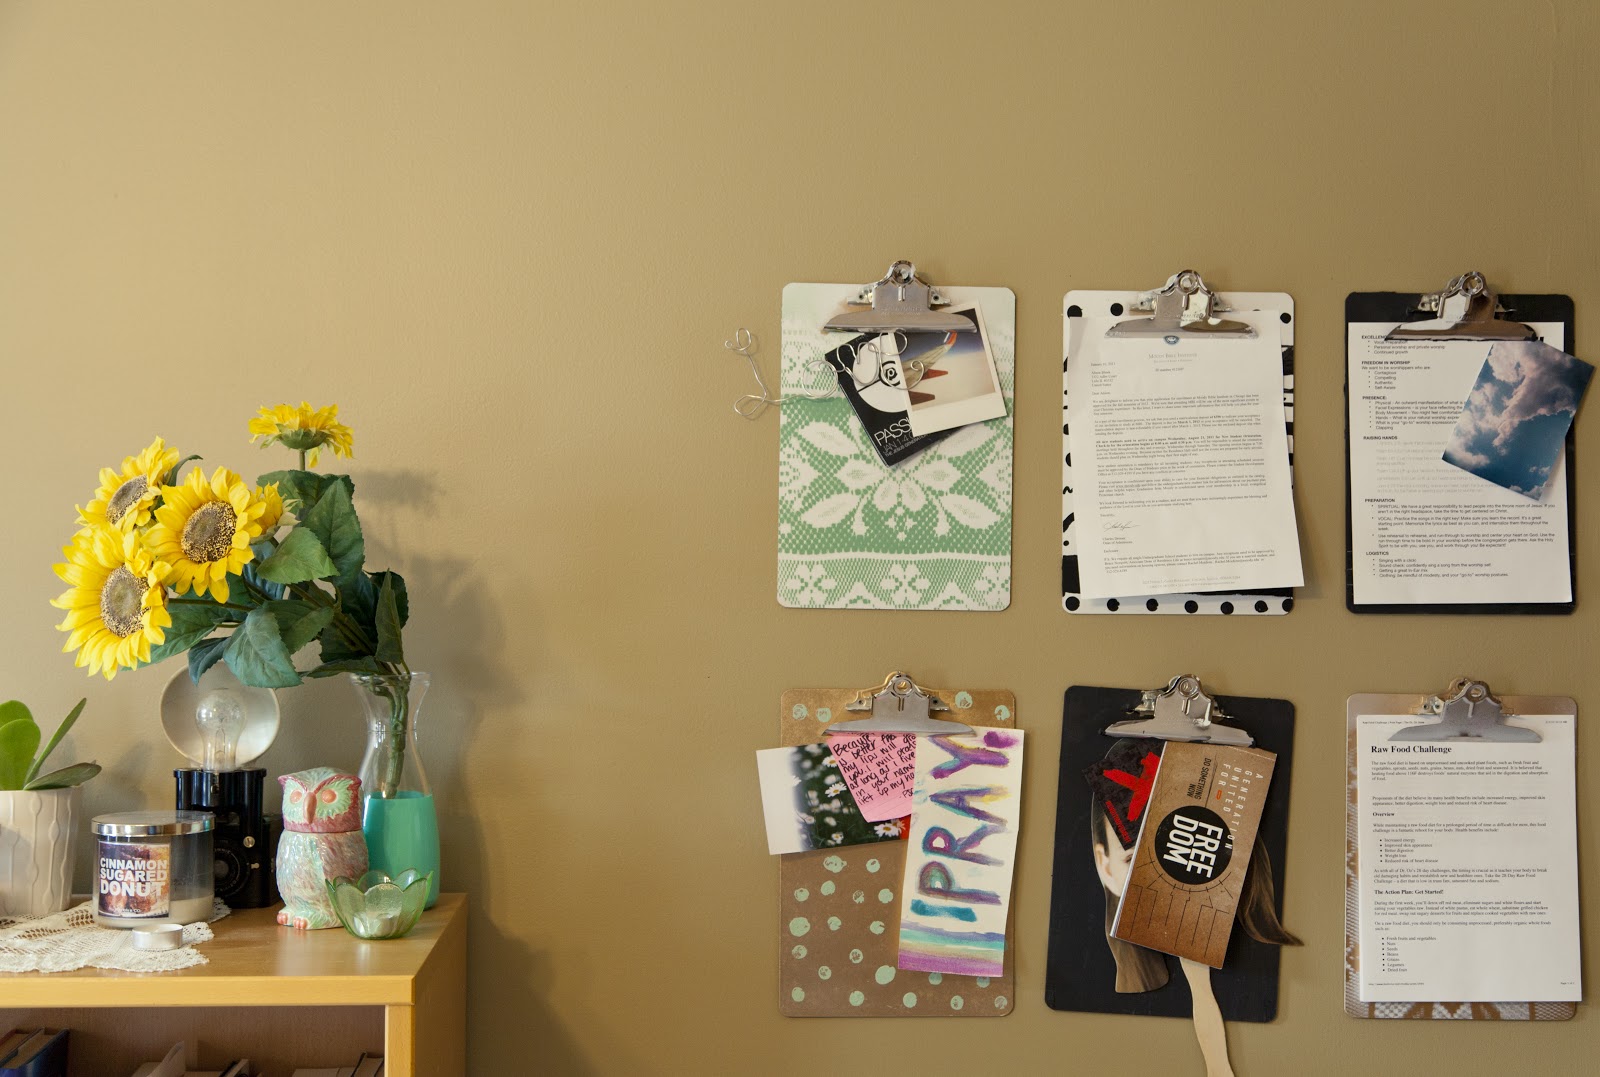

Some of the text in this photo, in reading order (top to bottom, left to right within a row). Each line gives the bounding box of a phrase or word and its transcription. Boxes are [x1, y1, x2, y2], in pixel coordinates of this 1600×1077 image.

[874, 417, 911, 446] PASS
[833, 734, 872, 756] Because
[851, 740, 875, 759] better
[1413, 746, 1452, 754] Challenge
[843, 762, 859, 774] my
[860, 753, 877, 763] lips
[880, 742, 896, 754] will
[860, 773, 879, 784] long
[900, 752, 915, 762] live
[876, 754, 893, 767] will
[856, 788, 865, 797] in
[872, 773, 889, 792] your
[1194, 757, 1212, 800] DO SOMETHING
[1218, 763, 1231, 786] FOR
[858, 794, 873, 805] lift
[879, 787, 889, 796] up
[890, 779, 905, 789] my
[1186, 783, 1196, 798] NOW
[1223, 767, 1242, 812] UNITED
[1224, 770, 1253, 850] GENERATION
[1163, 814, 1200, 867] DOM
[1186, 821, 1224, 878] FREE
[100, 857, 168, 870] CINNAMON
[100, 868, 168, 882] SUGARED
[100, 879, 166, 896] DONUT
